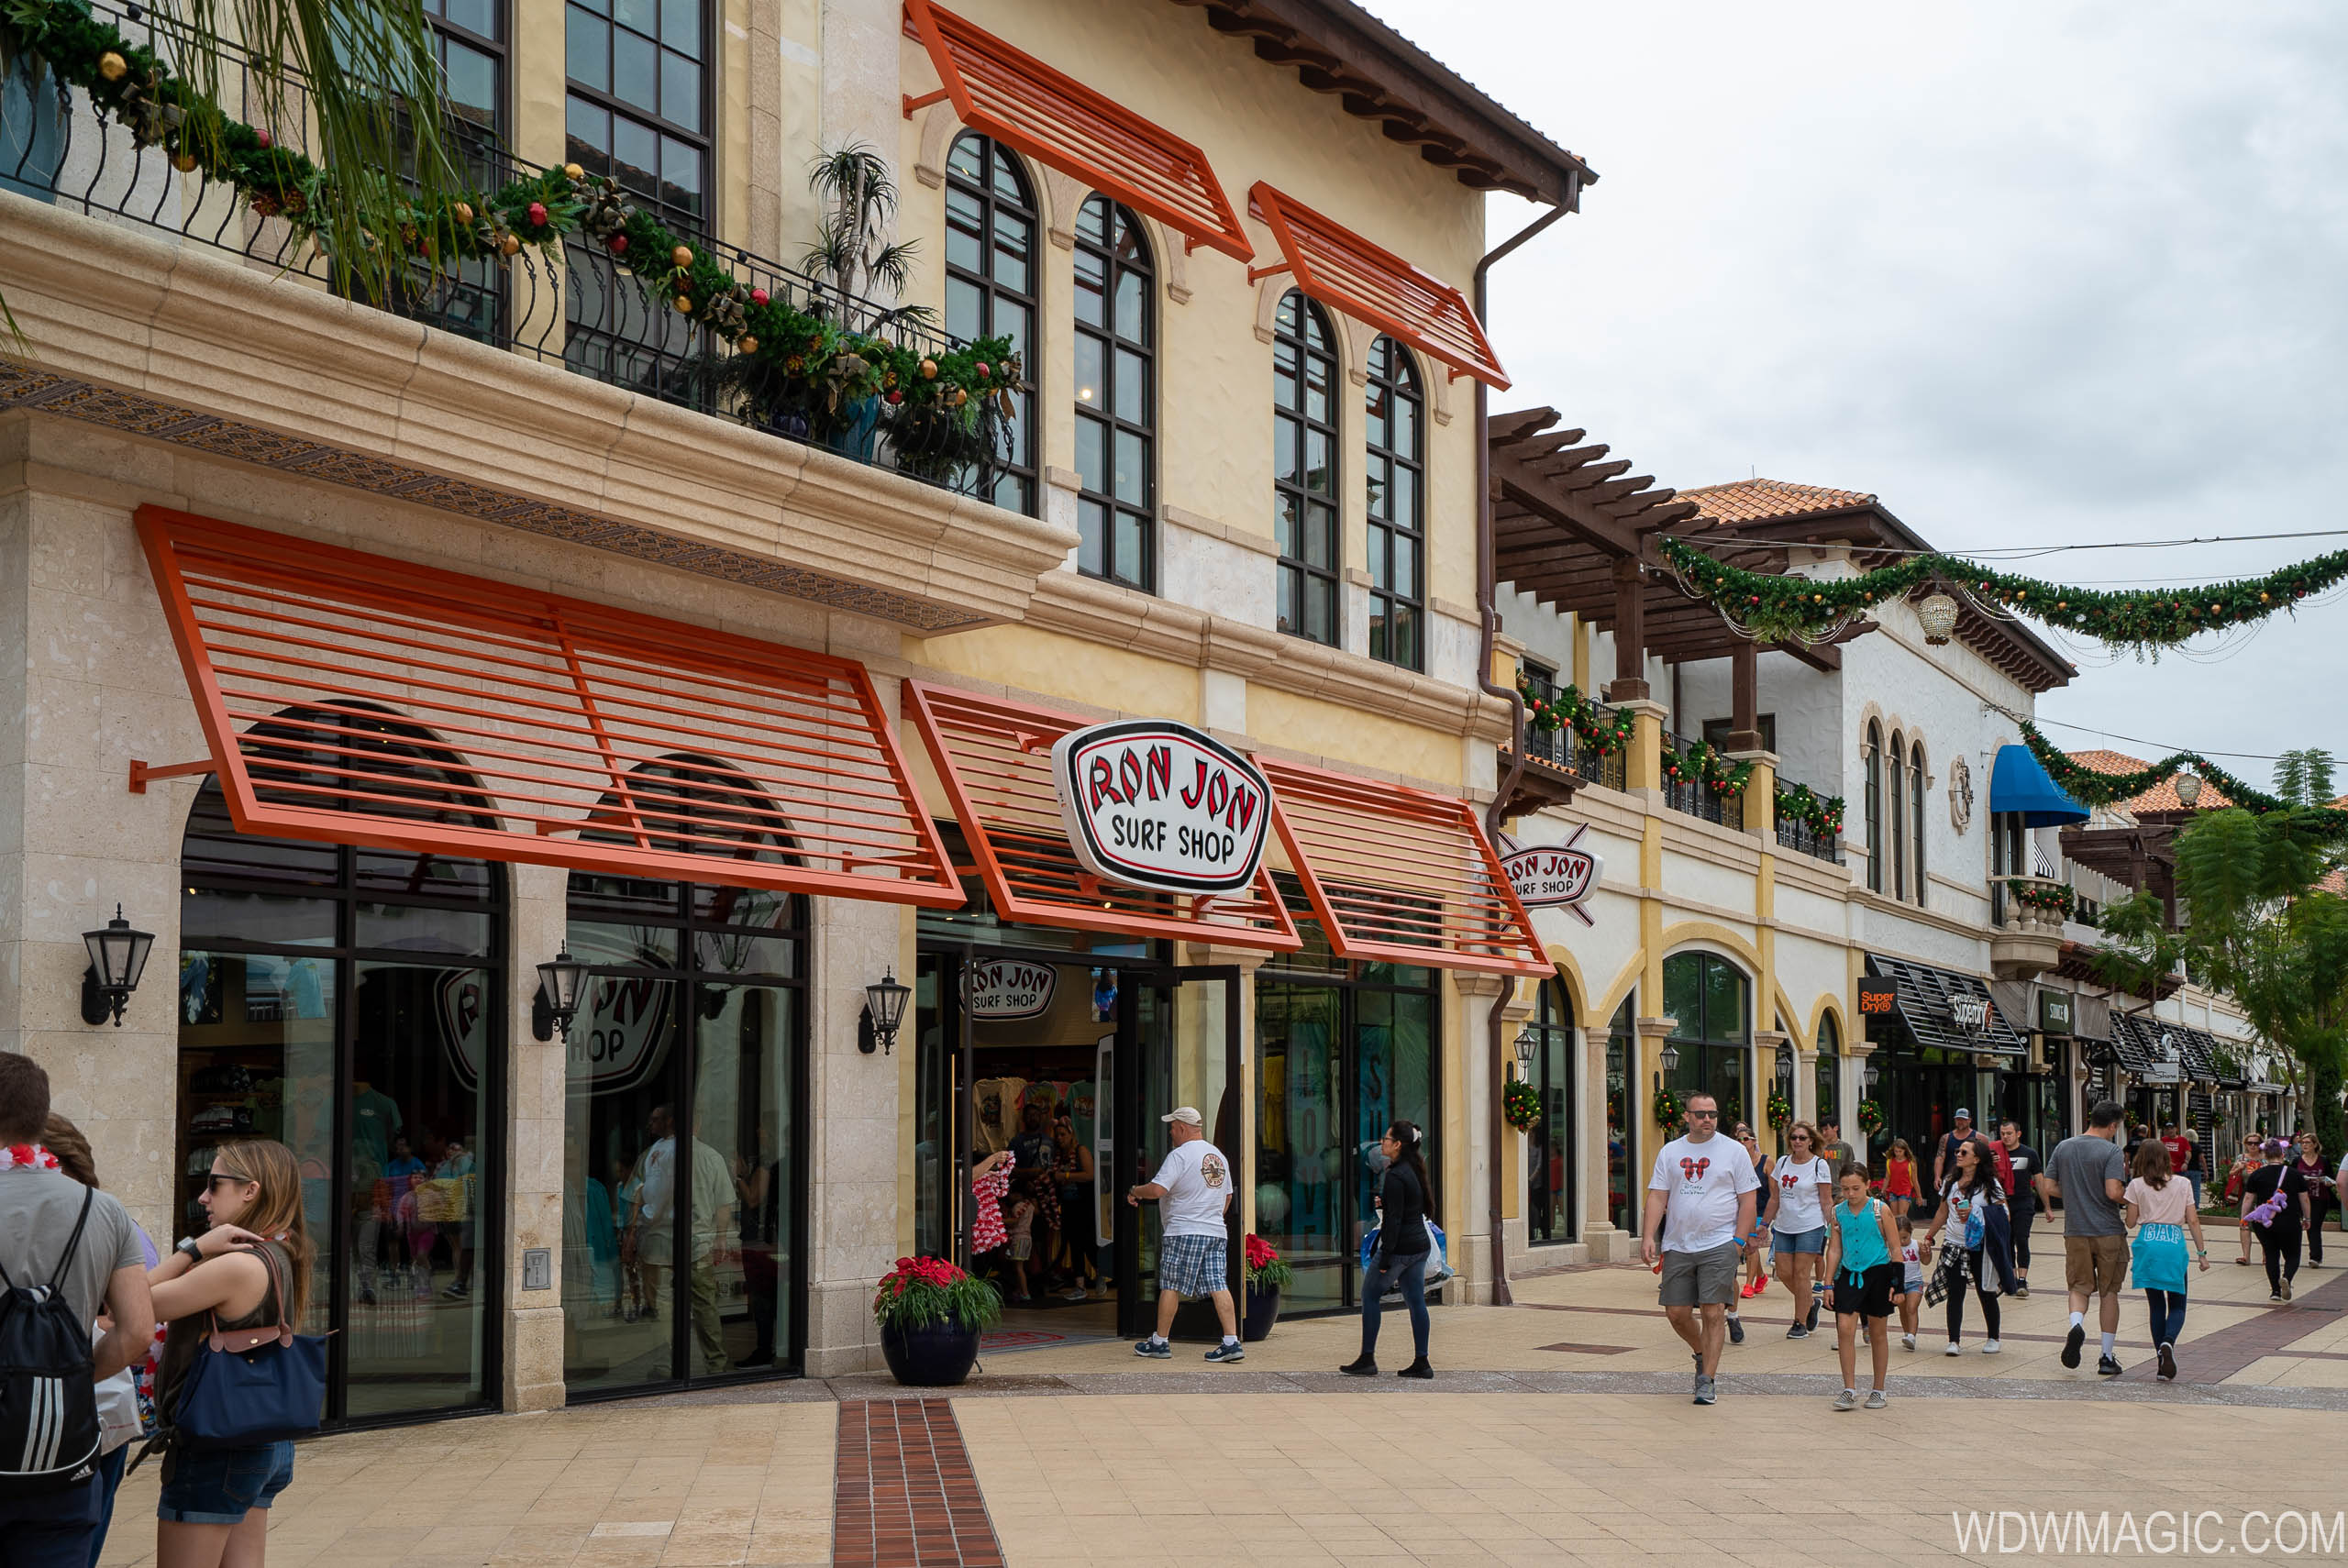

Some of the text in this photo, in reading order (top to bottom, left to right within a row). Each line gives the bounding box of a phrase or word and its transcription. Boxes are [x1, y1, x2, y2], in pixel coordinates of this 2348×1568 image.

[1090, 743, 1257, 836] RON JON
[1112, 815, 1235, 865] SURF SHOP
[1543, 856, 1587, 880] JON
[1512, 879, 1574, 896] URF SHOP
[1006, 966, 1049, 993] JON
[590, 976, 655, 1028] ON
[973, 993, 1036, 1009] SURF SHOP
[1861, 991, 1895, 1003] Super
[570, 1029, 625, 1063] HOP
[2143, 1222, 2182, 1244] GAP
